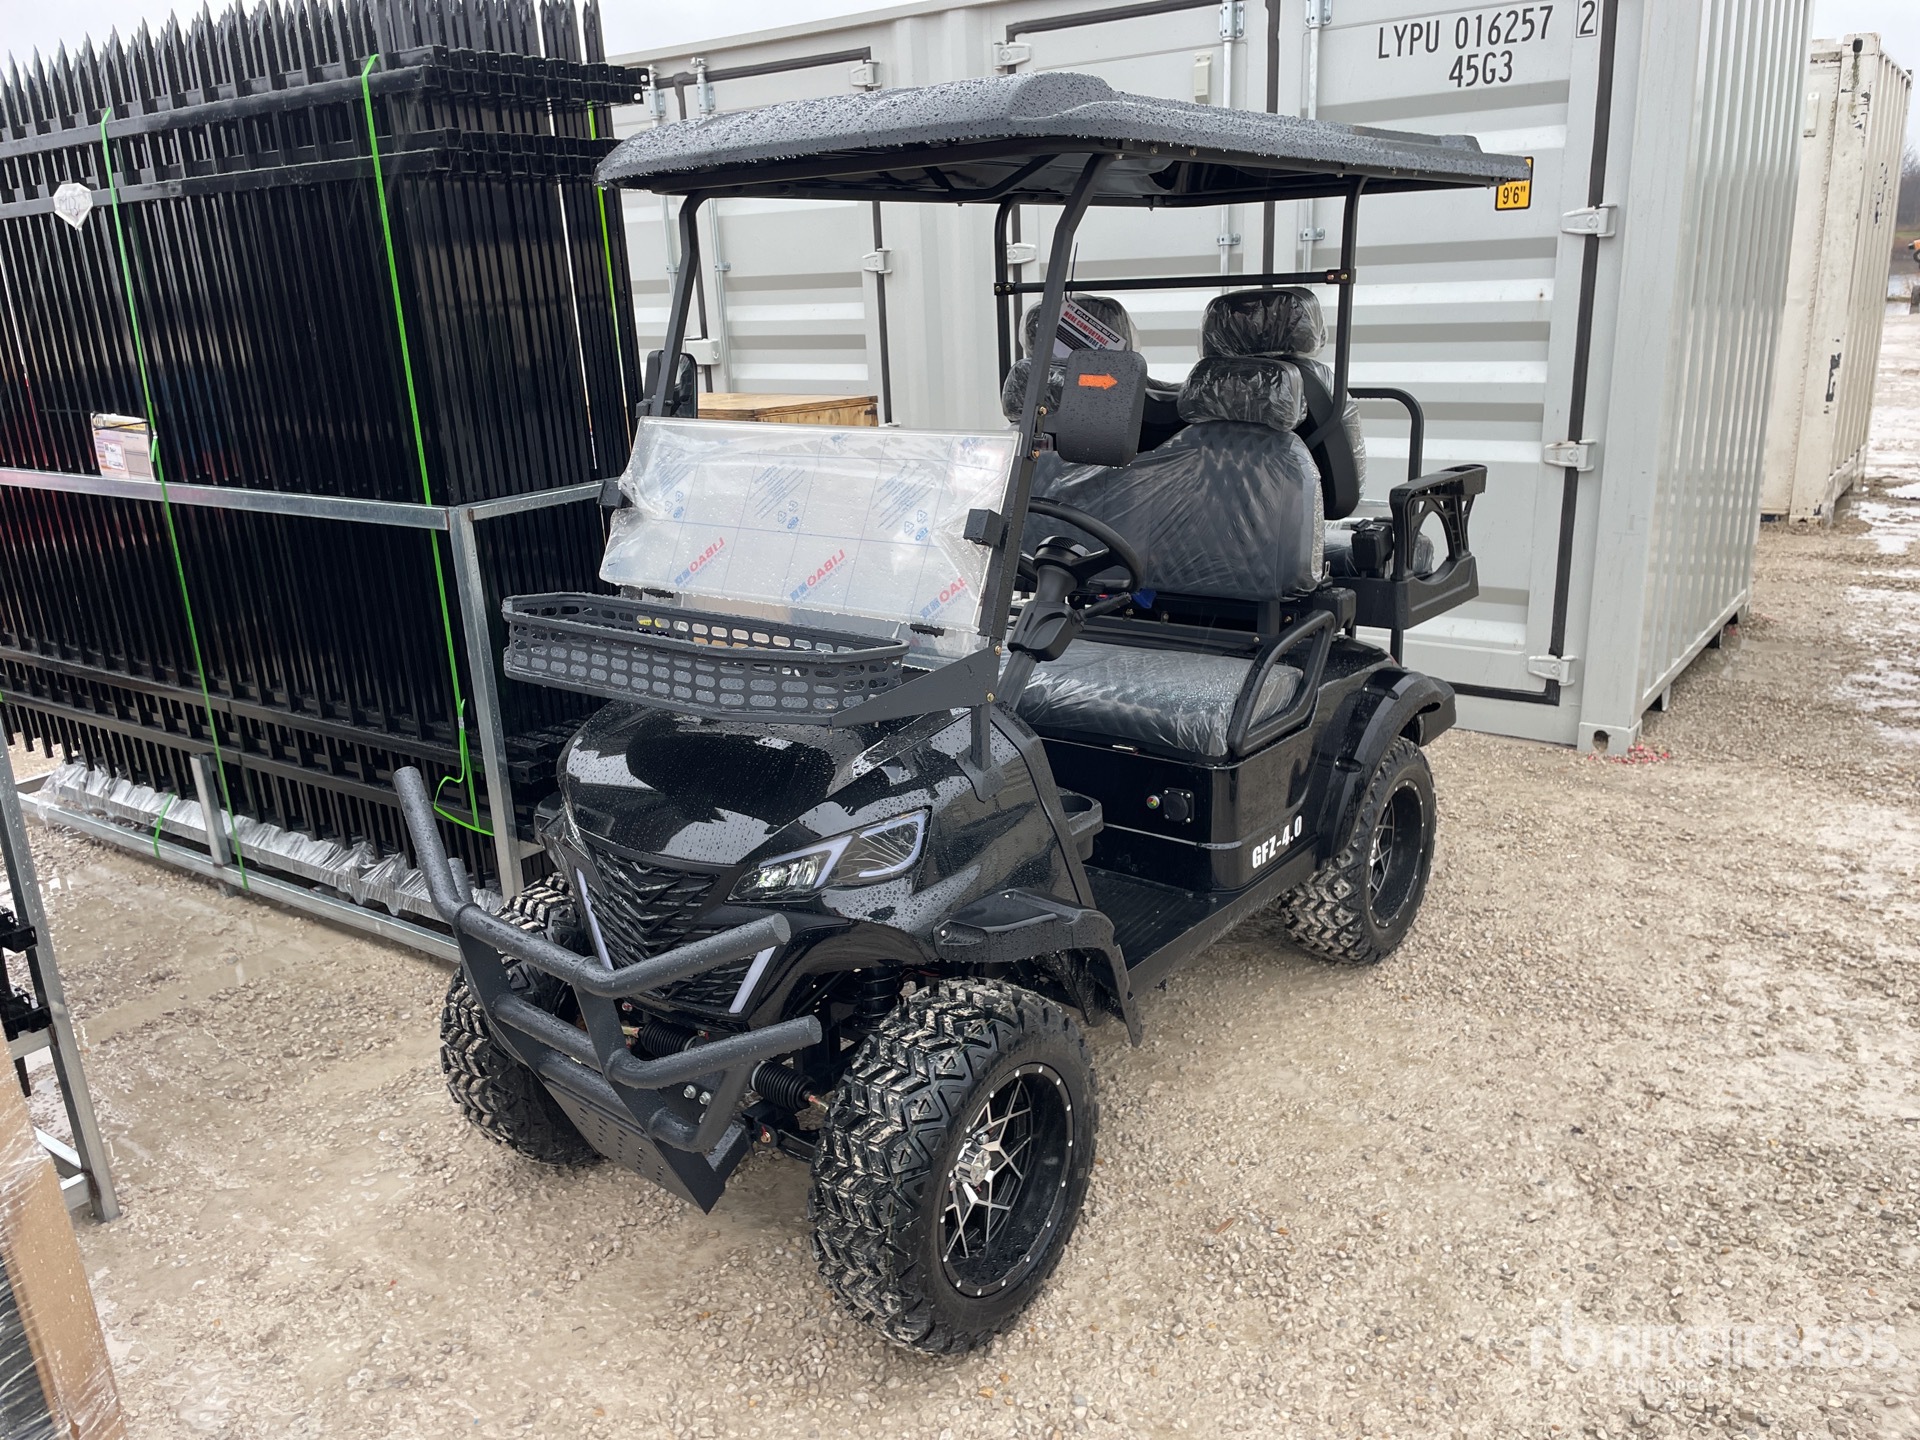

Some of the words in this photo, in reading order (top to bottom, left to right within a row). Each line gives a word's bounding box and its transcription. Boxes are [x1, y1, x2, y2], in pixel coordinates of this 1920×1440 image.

[1378, 20, 1440, 59] LYPU
[1455, 5, 1554, 50] 016257
[1579, 0, 1597, 36] 2
[1448, 50, 1513, 88] 45G3
[1502, 186, 1526, 205] 9'6"
[1063, 310, 1078, 323] MORE
[1076, 319, 1109, 346] COMFORTABLE
[1252, 815, 1302, 869] GFZ-4.0
